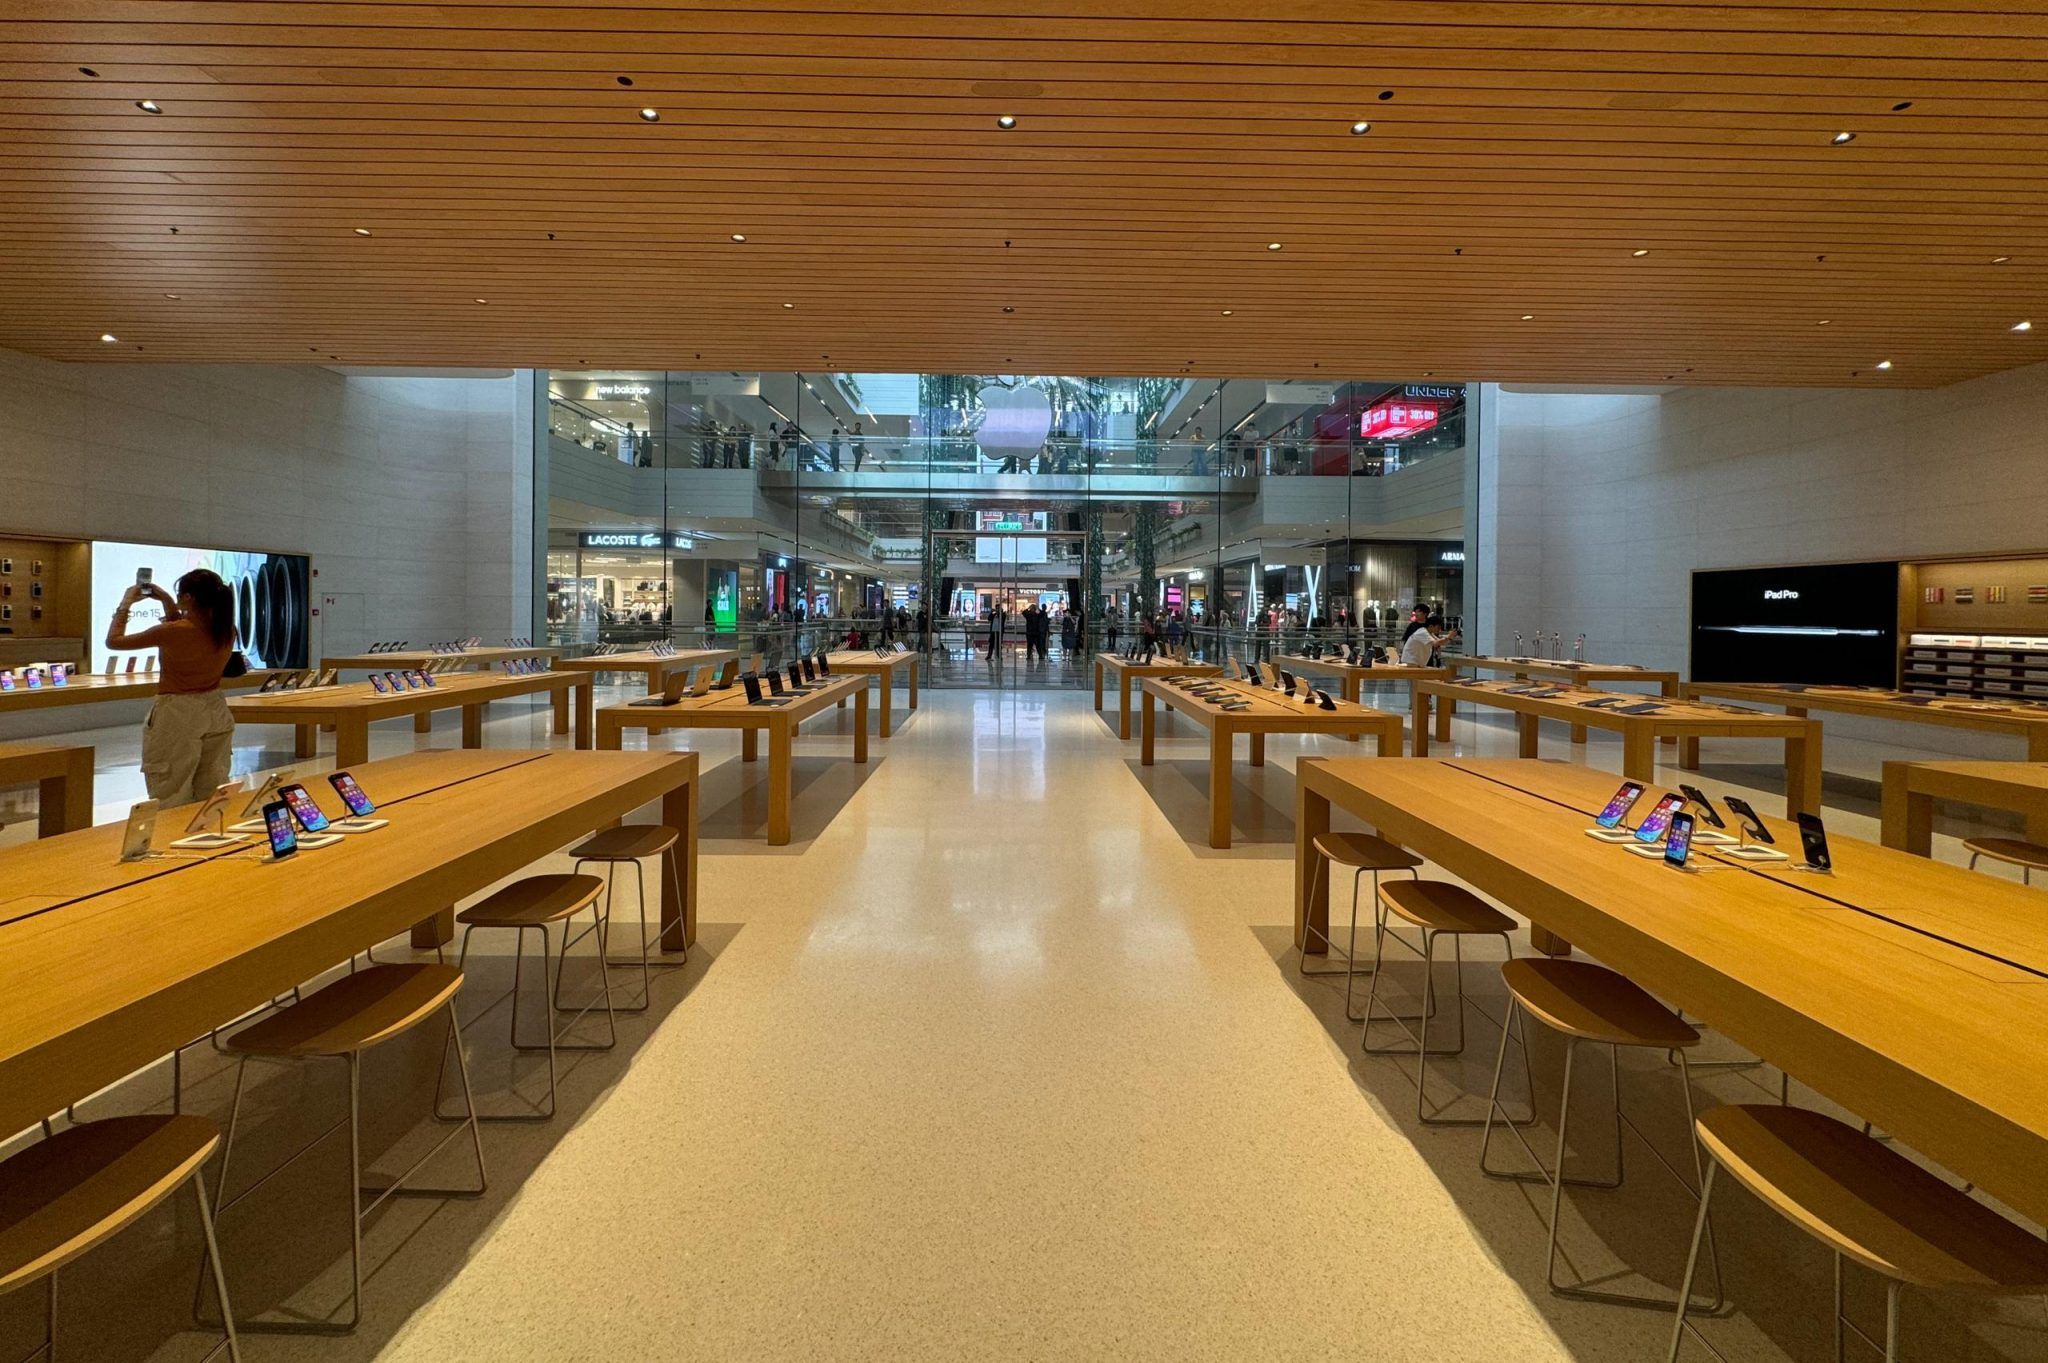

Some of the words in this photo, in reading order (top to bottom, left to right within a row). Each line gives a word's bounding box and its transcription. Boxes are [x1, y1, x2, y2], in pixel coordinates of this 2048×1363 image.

[614, 384, 651, 394] balance
[1405, 385, 1456, 398] UNDER
[588, 535, 637, 545] LACOSTE
[1764, 590, 1782, 599] iPad
[1783, 589, 1799, 599] Pro
